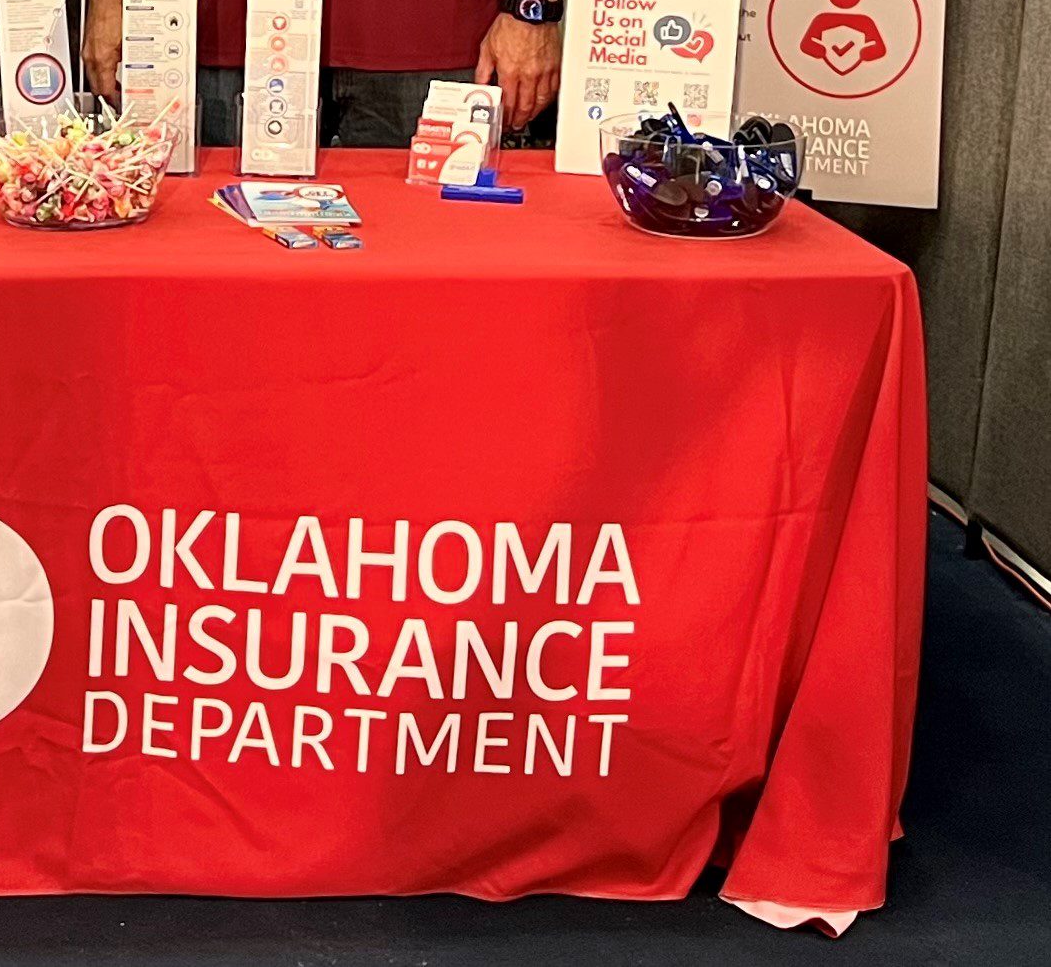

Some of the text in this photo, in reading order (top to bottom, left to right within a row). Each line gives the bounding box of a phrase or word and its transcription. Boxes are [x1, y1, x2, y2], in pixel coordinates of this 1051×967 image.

[591, 29, 646, 47] Social
[593, 11, 643, 28] Us on
[589, 47, 647, 66] Media
[88, 502, 641, 607] OKLAHOMA
[88, 596, 639, 705] INSURANCE
[81, 690, 630, 778] DEPARTMENT
